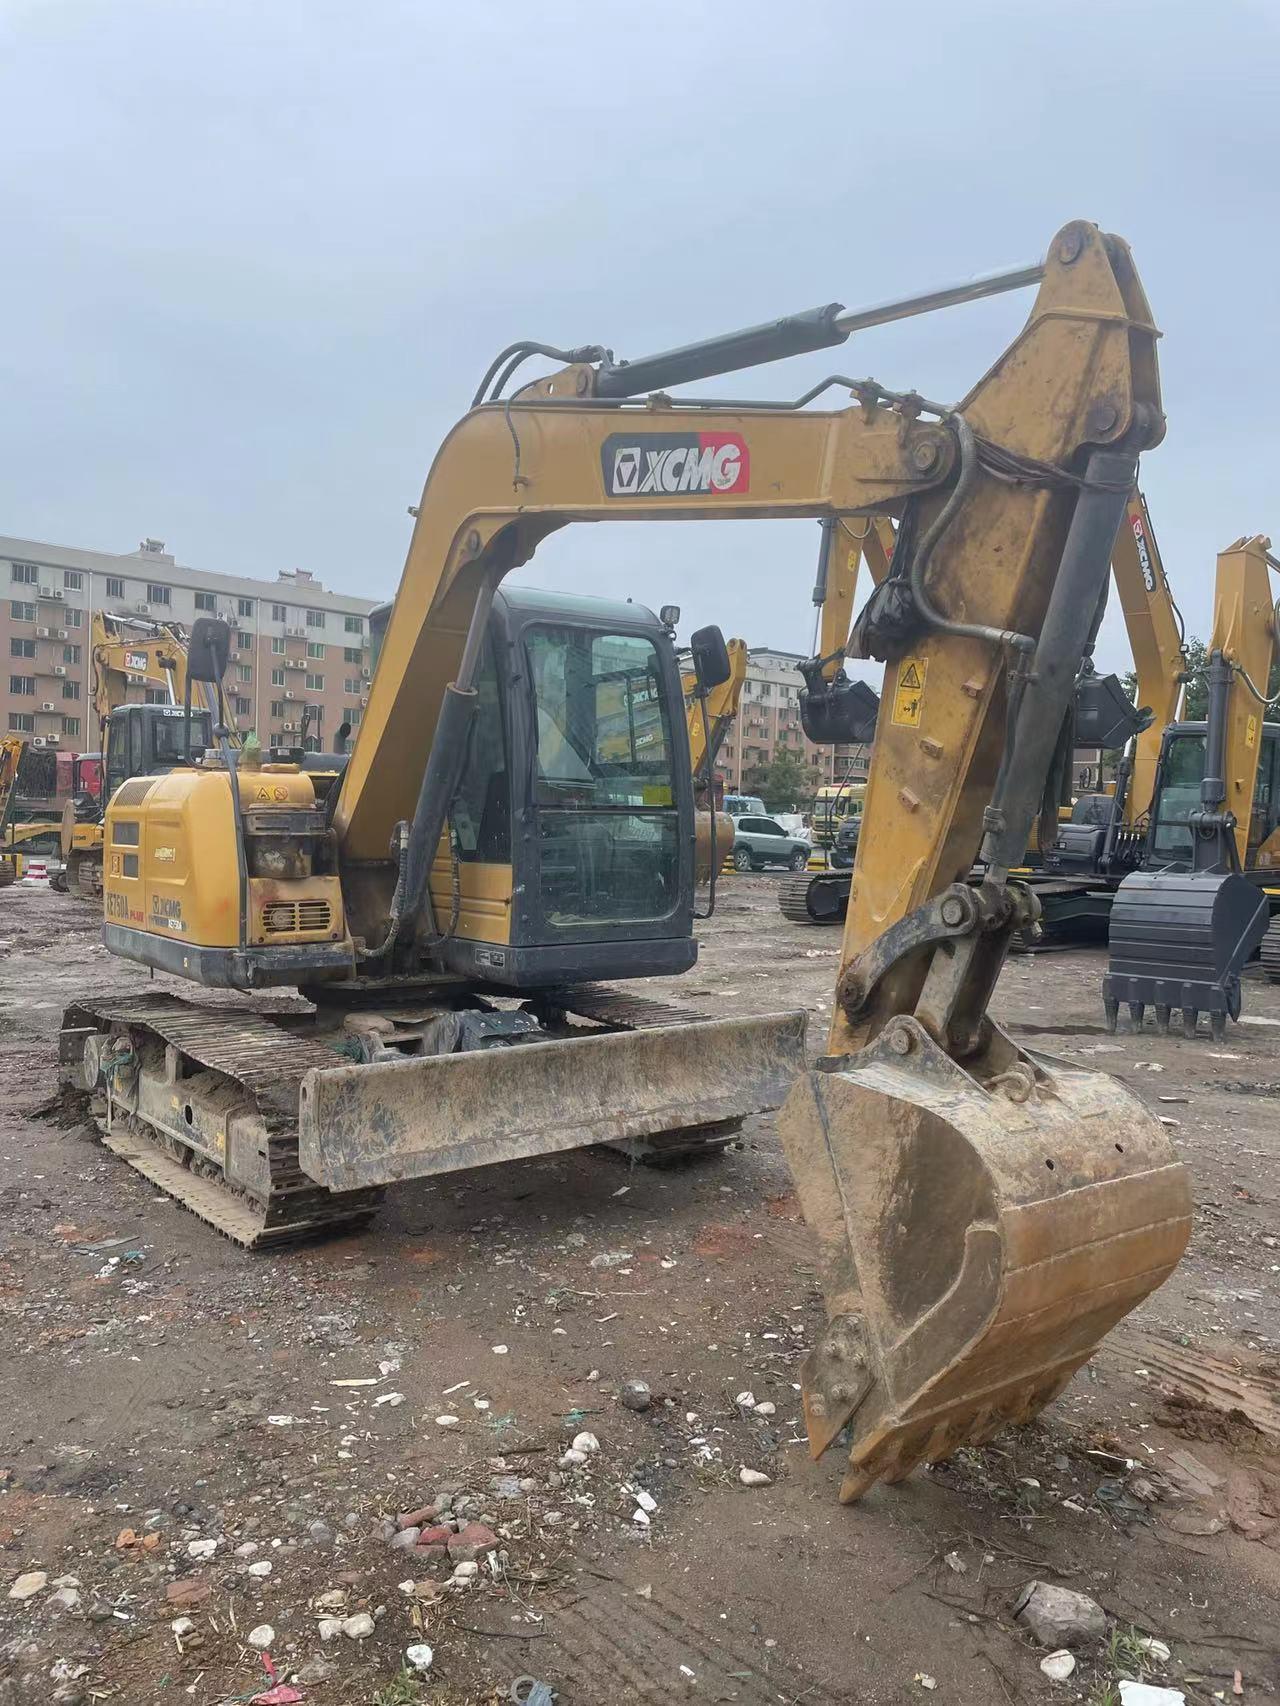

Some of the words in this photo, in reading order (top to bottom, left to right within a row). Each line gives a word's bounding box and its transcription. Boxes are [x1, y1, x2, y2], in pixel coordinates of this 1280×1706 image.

[637, 444, 742, 492] XCMG
[1136, 537, 1153, 591] XCMG
[131, 655, 147, 671] XCMG
[160, 897, 182, 919] XCMG
